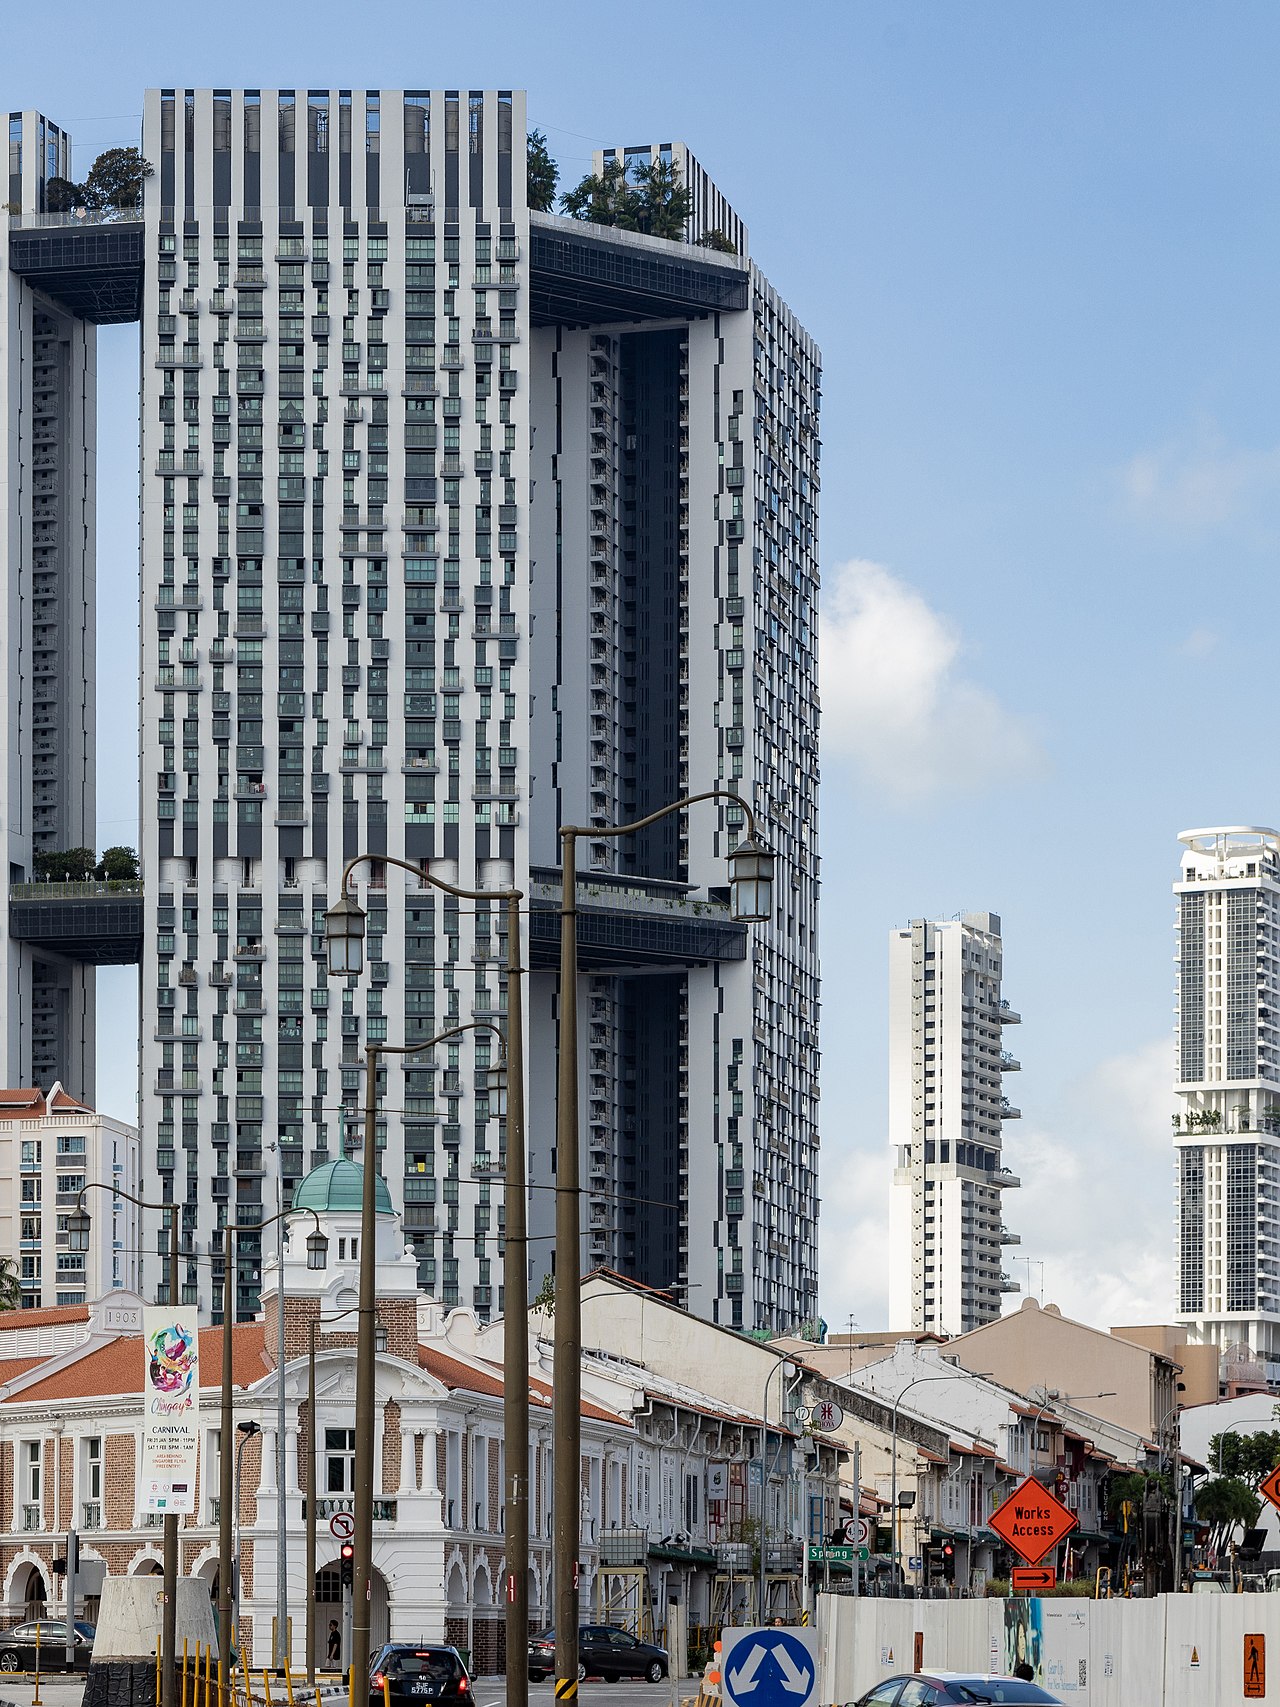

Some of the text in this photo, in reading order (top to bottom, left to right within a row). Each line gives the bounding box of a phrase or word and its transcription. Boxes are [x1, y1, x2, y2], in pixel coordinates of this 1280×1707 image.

[108, 1311, 137, 1323] 1903
[798, 1408, 806, 1419] 17
[152, 1426, 190, 1434] CARNIVAL
[1014, 1506, 1051, 1520] Works
[1011, 1523, 1054, 1537] Access
[509, 1575, 515, 1602] 11
[164, 1595, 169, 1603] 5
